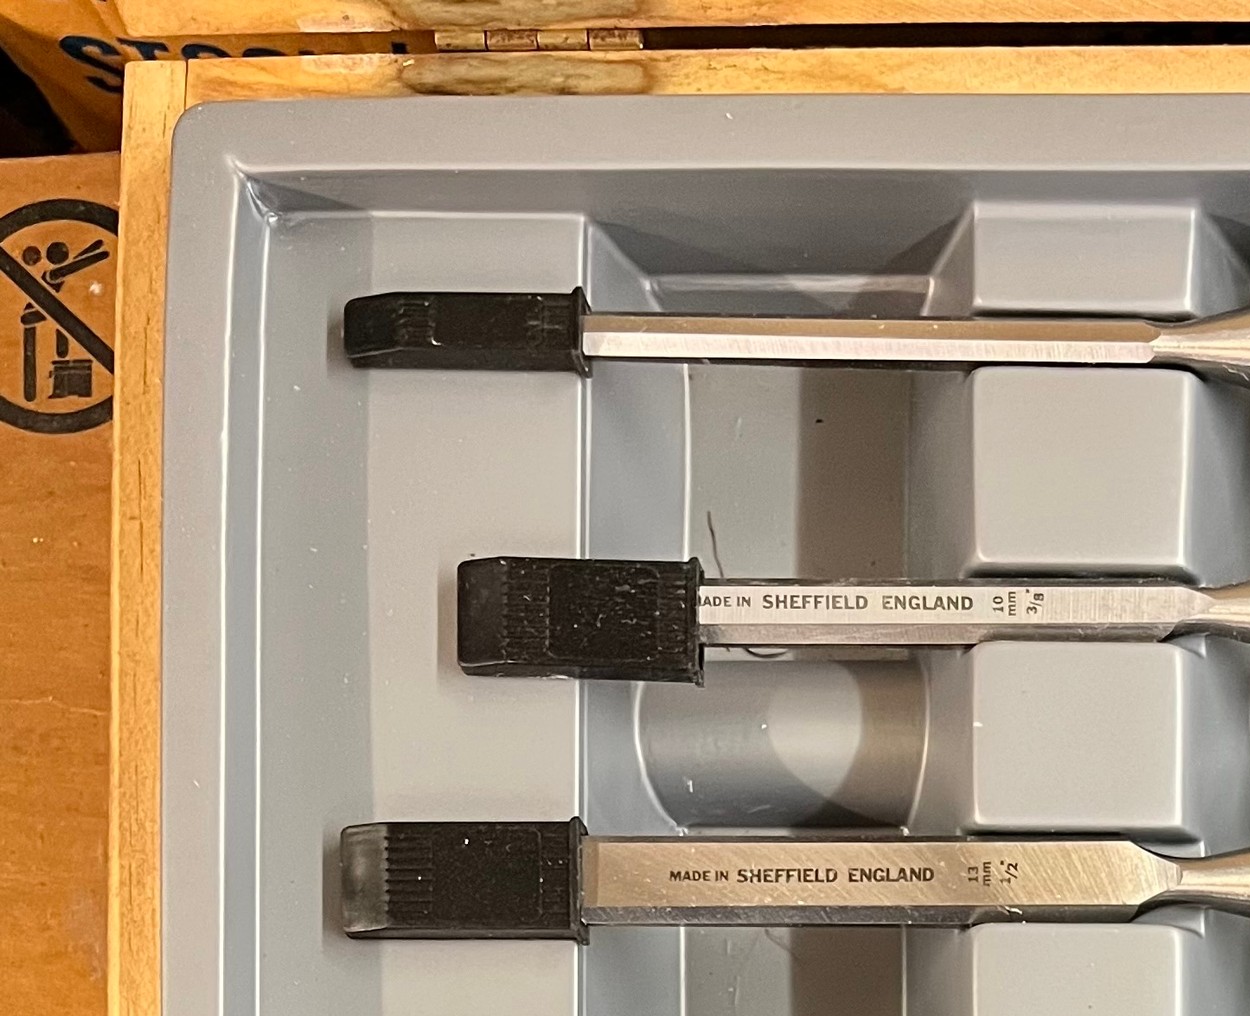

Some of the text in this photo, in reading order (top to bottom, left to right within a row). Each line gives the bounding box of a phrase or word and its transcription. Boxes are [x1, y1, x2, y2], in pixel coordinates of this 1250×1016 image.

[698, 593, 974, 611] ADE IN SHEFFIELD ENGLAND
[991, 595, 1005, 614] 10
[1006, 590, 1018, 618] mm
[669, 866, 935, 884] MADE IN SHEFFIELD ENGLAND
[967, 865, 979, 883] 13
[981, 860, 993, 888] mm
